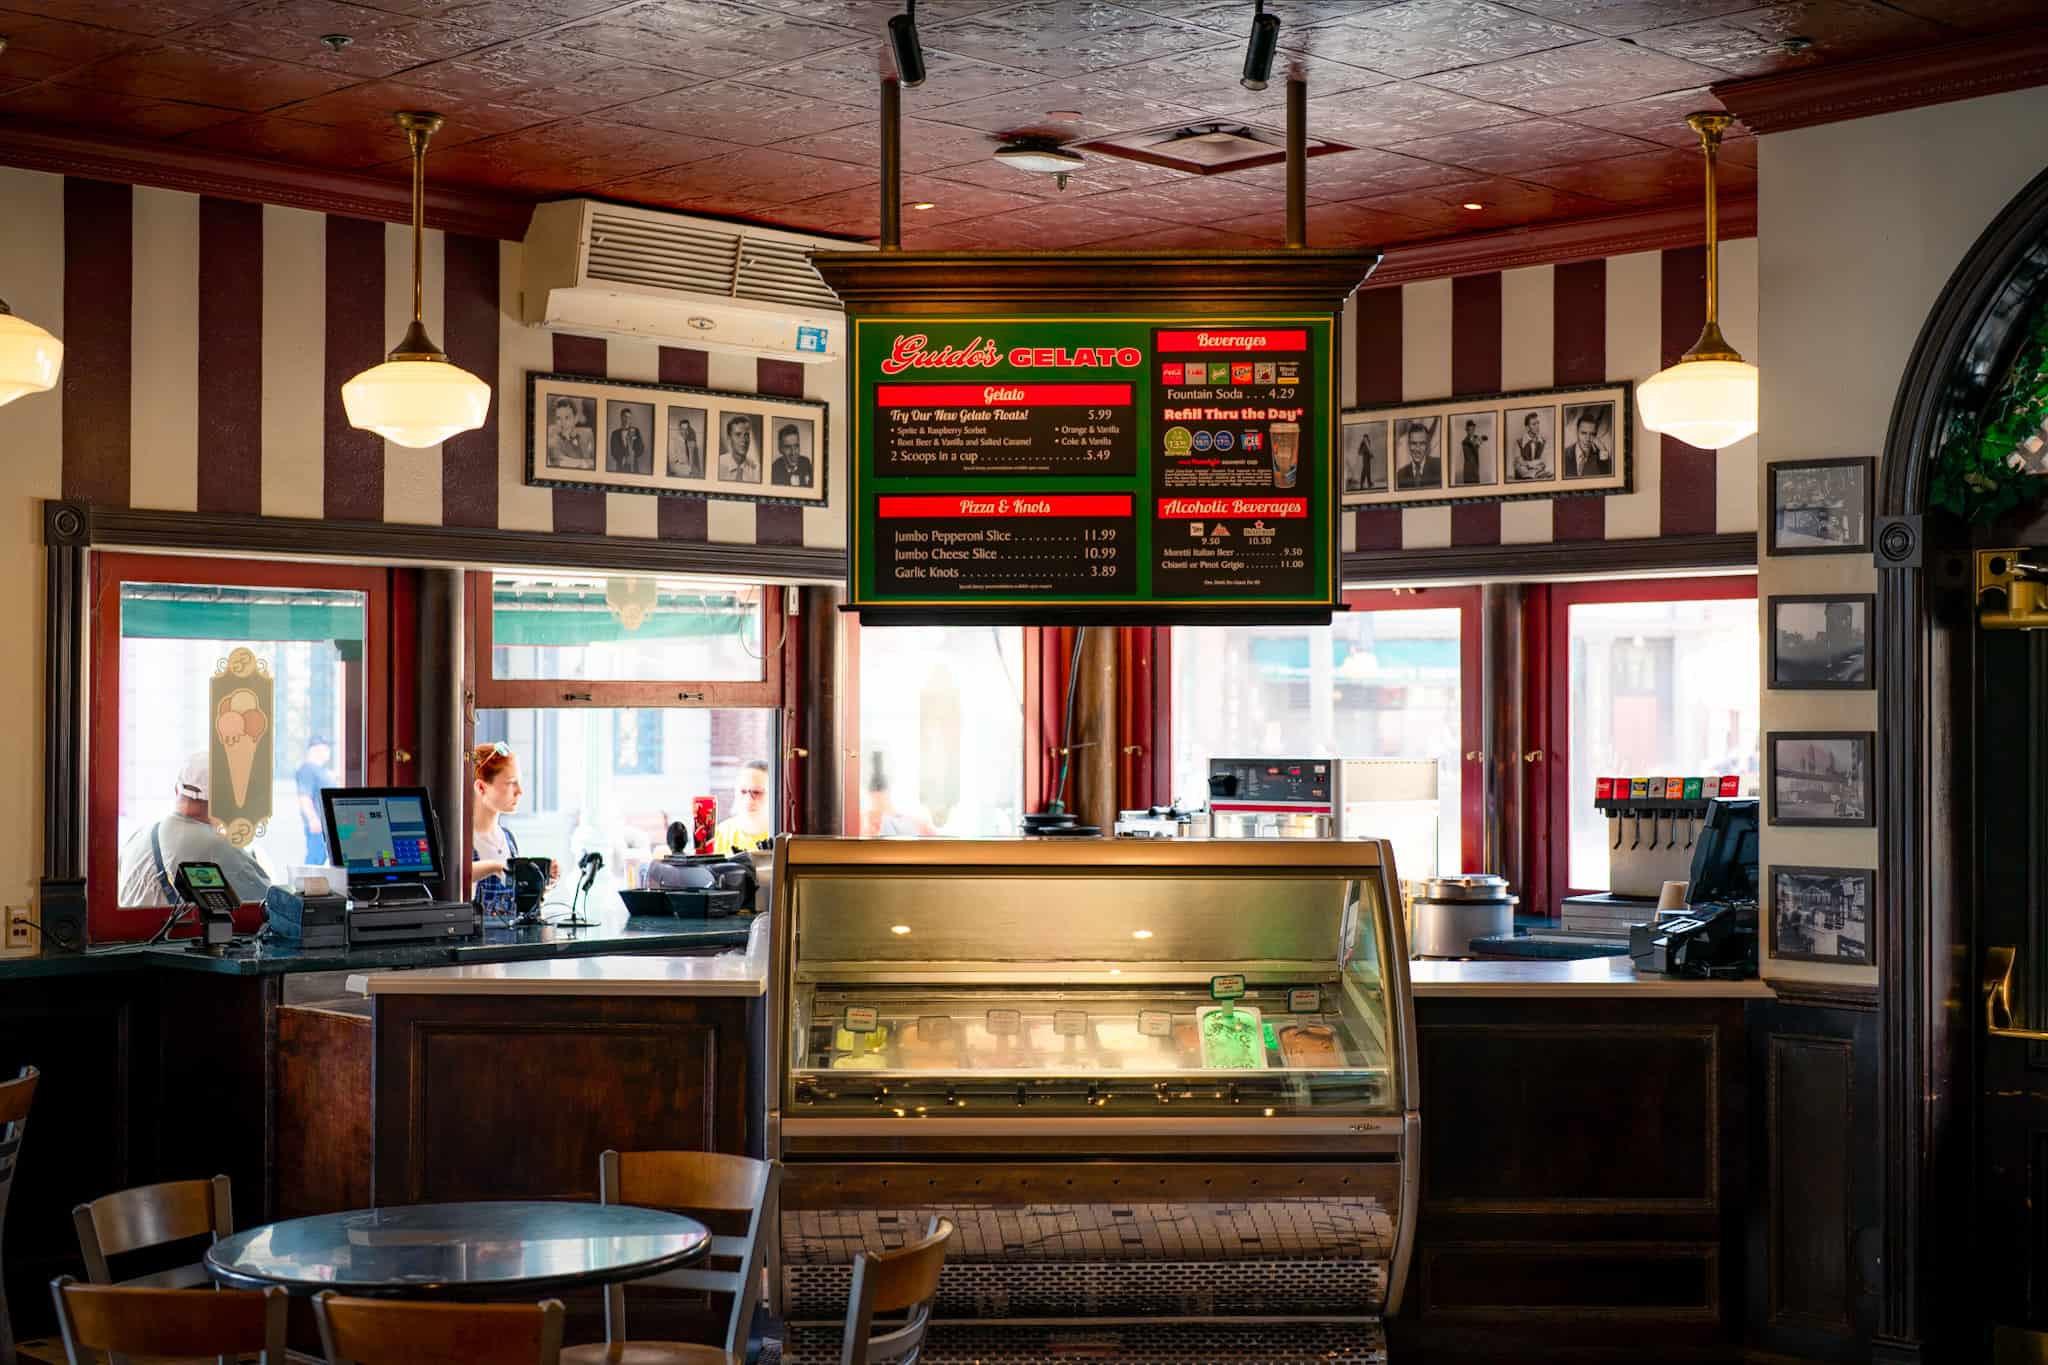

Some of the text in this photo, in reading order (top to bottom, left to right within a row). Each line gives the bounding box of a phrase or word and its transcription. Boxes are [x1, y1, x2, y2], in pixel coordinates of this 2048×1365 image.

[1197, 333, 1266, 350] Beverages
[881, 334, 1142, 375] Guido's GELATO
[983, 387, 1025, 404] Gelato
[1168, 388, 1295, 400] Fountain Soda 4.29
[890, 409, 1112, 423] Try Our New Gelato Floats! 5.99
[1164, 409, 1201, 420] Refill
[1204, 409, 1238, 420] Thru
[1241, 409, 1265, 419] the
[927, 426, 961, 436] Raspberry
[963, 426, 987, 434] Sorbet
[1061, 426, 1087, 436] Orange
[1097, 425, 1120, 434] Vanilla
[897, 438, 915, 446] Root
[916, 438, 931, 446] Beer
[941, 437, 963, 446] Vanilla
[966, 437, 979, 446] and
[980, 437, 1001, 446] Salted
[1003, 437, 1031, 446] Caramel
[1061, 437, 1079, 446] Coke
[1089, 436, 1112, 446] Vanilla
[891, 451, 897, 461] 2
[900, 451, 936, 464] Scoops
[939, 451, 948, 460] in
[960, 453, 978, 464] cup
[1087, 450, 1111, 460] 5.49
[960, 500, 1051, 514] Pizza & Knots
[1164, 500, 1302, 517] Alcoholic Beverages
[895, 529, 1116, 544] Jumbo Pepperoni Slice 11.99
[1201, 537, 1220, 545] 9.50
[1248, 537, 1272, 545] 10.50
[895, 547, 1116, 561] Jumbo Cheese Slice 10.99
[1283, 548, 1303, 557] 9.50
[1200, 560, 1219, 569] Pinot
[1281, 559, 1304, 569] 11.00
[895, 566, 1117, 579] Garlic Knots 3.89
